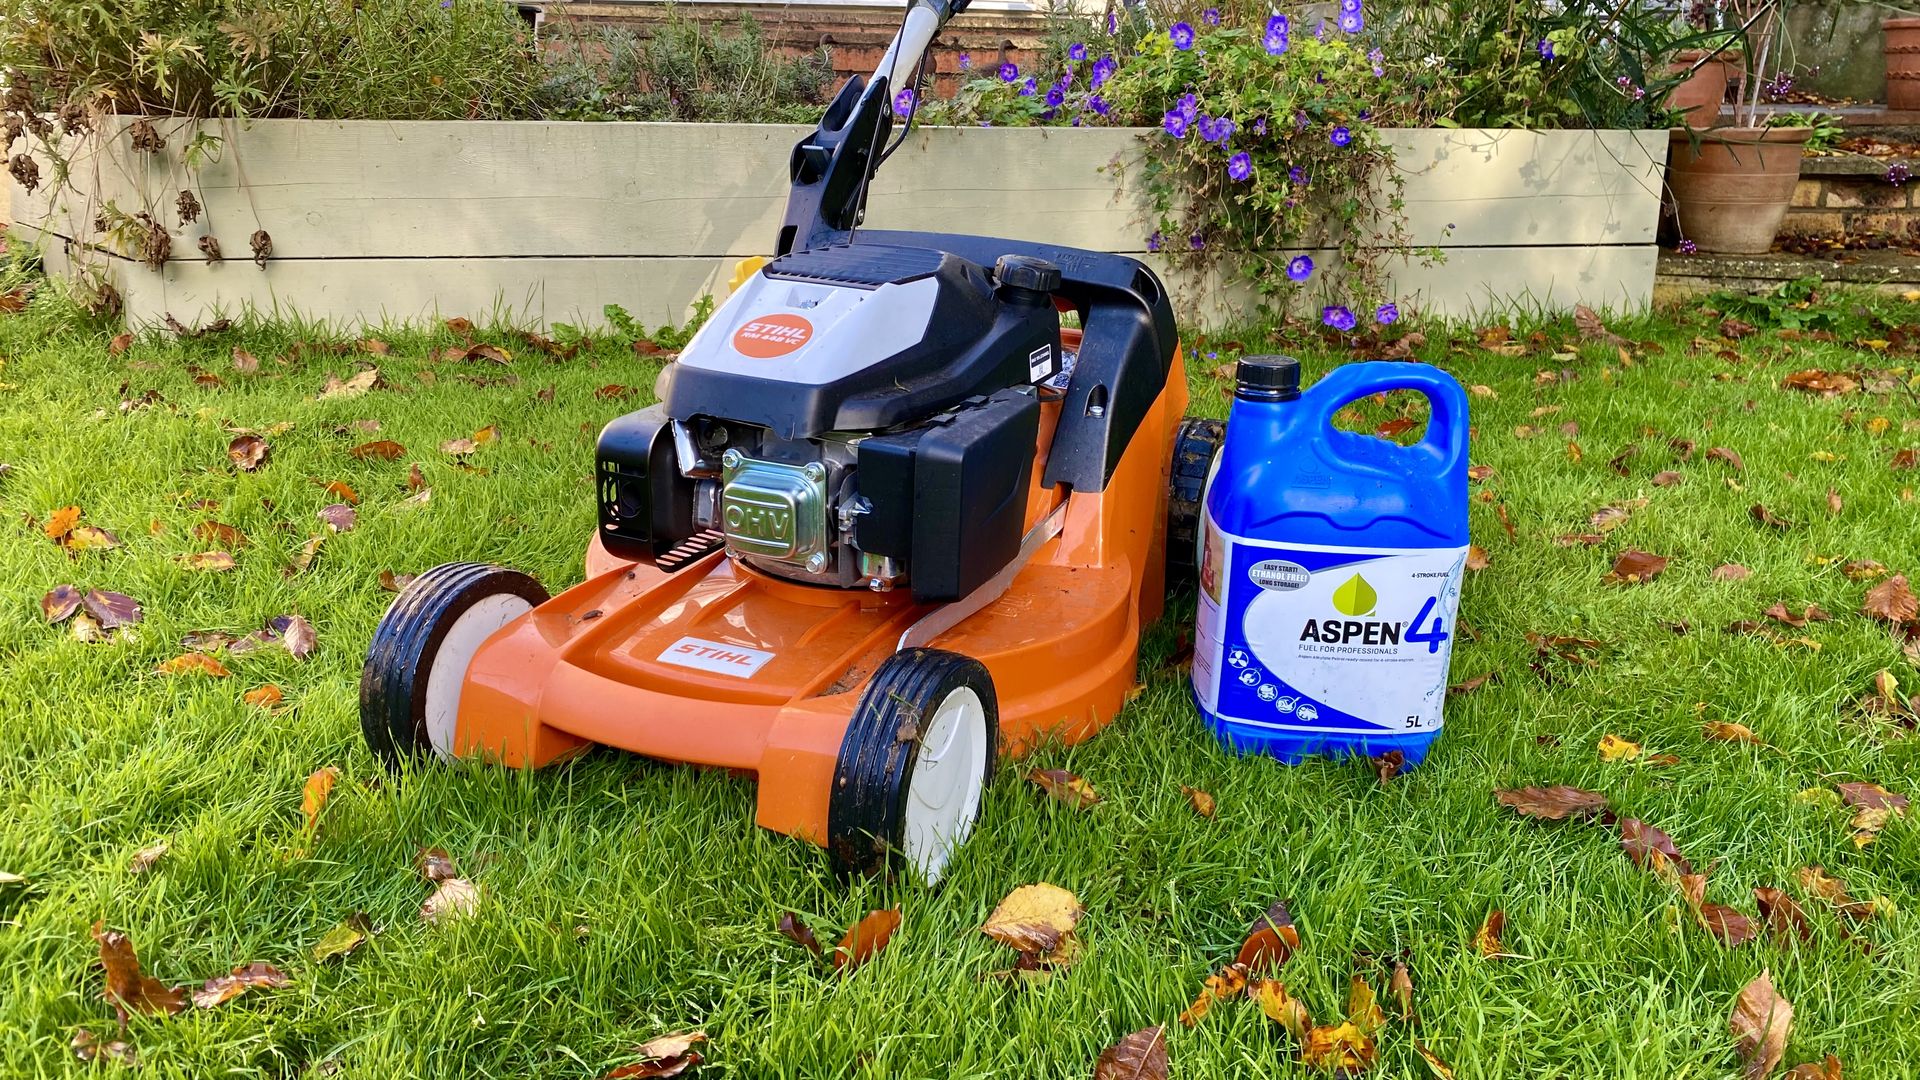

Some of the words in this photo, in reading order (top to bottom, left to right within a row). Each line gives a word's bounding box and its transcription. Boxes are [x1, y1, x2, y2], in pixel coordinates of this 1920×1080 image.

[744, 322, 806, 340] STIHL
[785, 337, 801, 345] VC
[726, 504, 789, 540] OHV
[1278, 565, 1298, 573] START!
[1252, 570, 1285, 580] ETHANOL
[1286, 573, 1307, 582] FREE!
[1273, 580, 1300, 588] STORAGE!
[1404, 596, 1448, 654] 4
[674, 643, 752, 666] STIHL
[1298, 643, 1318, 652] FUEL
[1319, 645, 1336, 653] FOR
[1336, 646, 1399, 655] PROFESSIONALS
[1405, 715, 1423, 728] 5L
